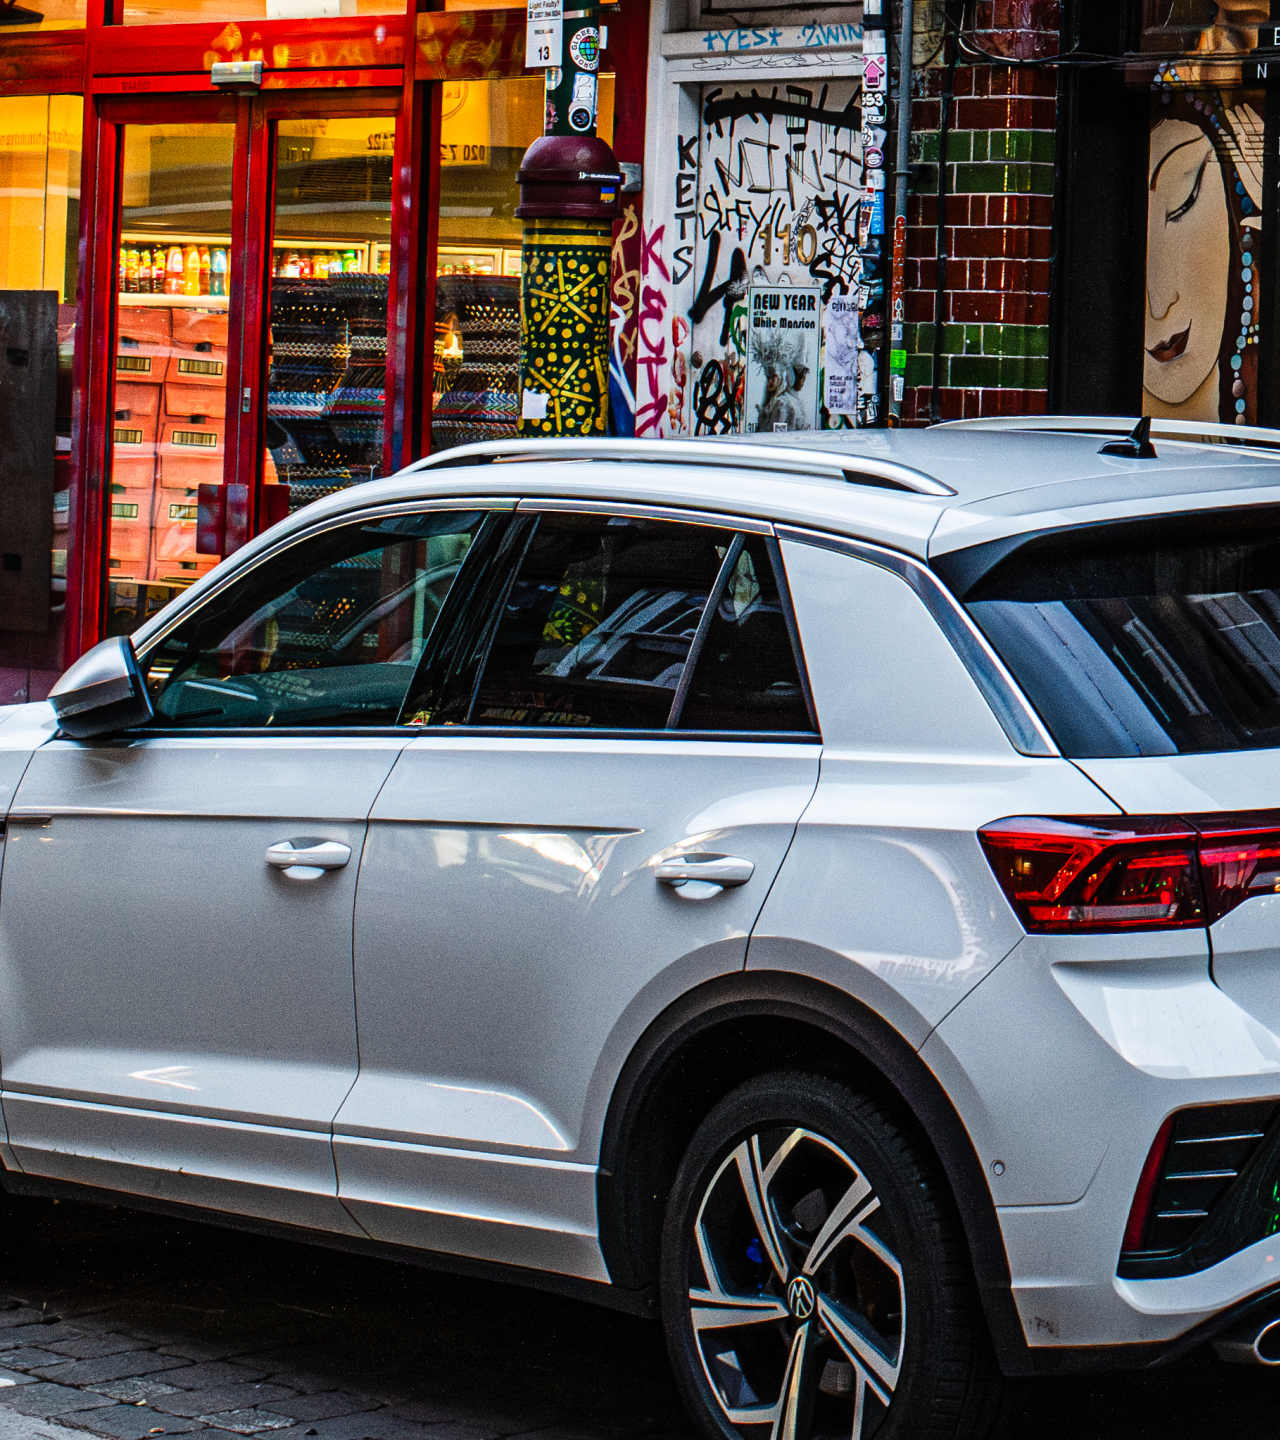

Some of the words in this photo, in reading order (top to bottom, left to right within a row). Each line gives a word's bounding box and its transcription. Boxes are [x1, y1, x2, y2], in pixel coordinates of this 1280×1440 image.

[537, 45, 550, 61] 13
[759, 223, 818, 266] 110
[753, 294, 780, 310] NEW
[784, 294, 816, 310] YEAR
[753, 317, 778, 328] White
[779, 317, 816, 329] Mansion
